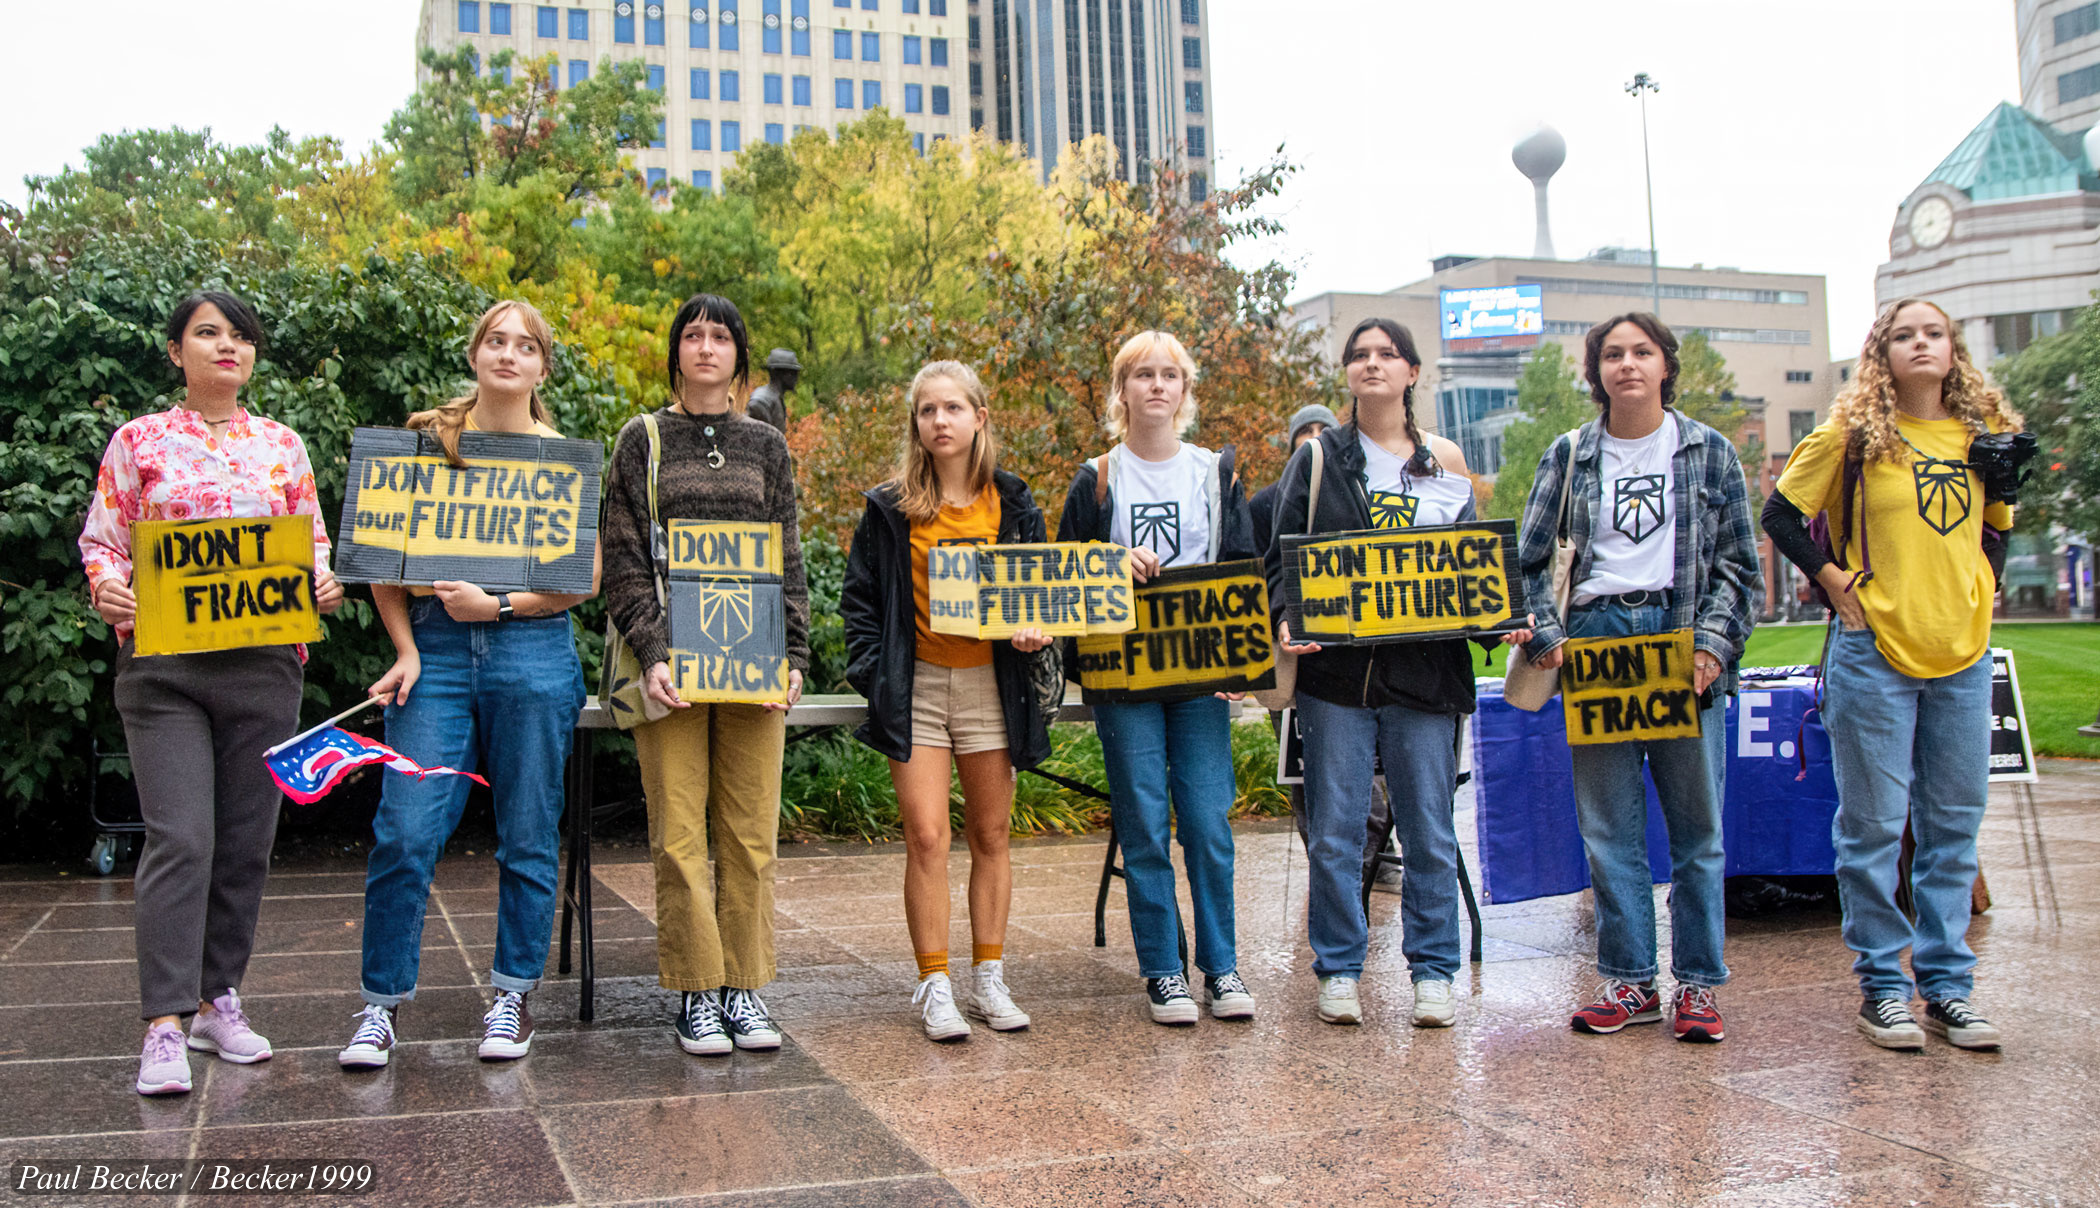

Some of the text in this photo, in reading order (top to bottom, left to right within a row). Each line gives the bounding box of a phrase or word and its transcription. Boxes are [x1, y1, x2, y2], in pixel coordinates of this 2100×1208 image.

[463, 466, 578, 504] FRACK
[356, 500, 571, 547] OUR FUTURES
[163, 524, 271, 569] DON'T
[673, 530, 769, 568] DON'T
[1020, 548, 1126, 582] FRACK
[1391, 536, 1499, 575] FRACK
[184, 575, 303, 624] FRACK
[930, 600, 974, 619] OUR
[979, 585, 1129, 626] FUTURES
[1303, 574, 1504, 622] OUR FUTURES
[1079, 623, 1270, 676] OUR FUTURES
[1574, 640, 1673, 682] DON'T
[675, 654, 783, 692] FRACK
[1578, 689, 1692, 735] FRACK
[1725, 692, 1795, 758] E.
